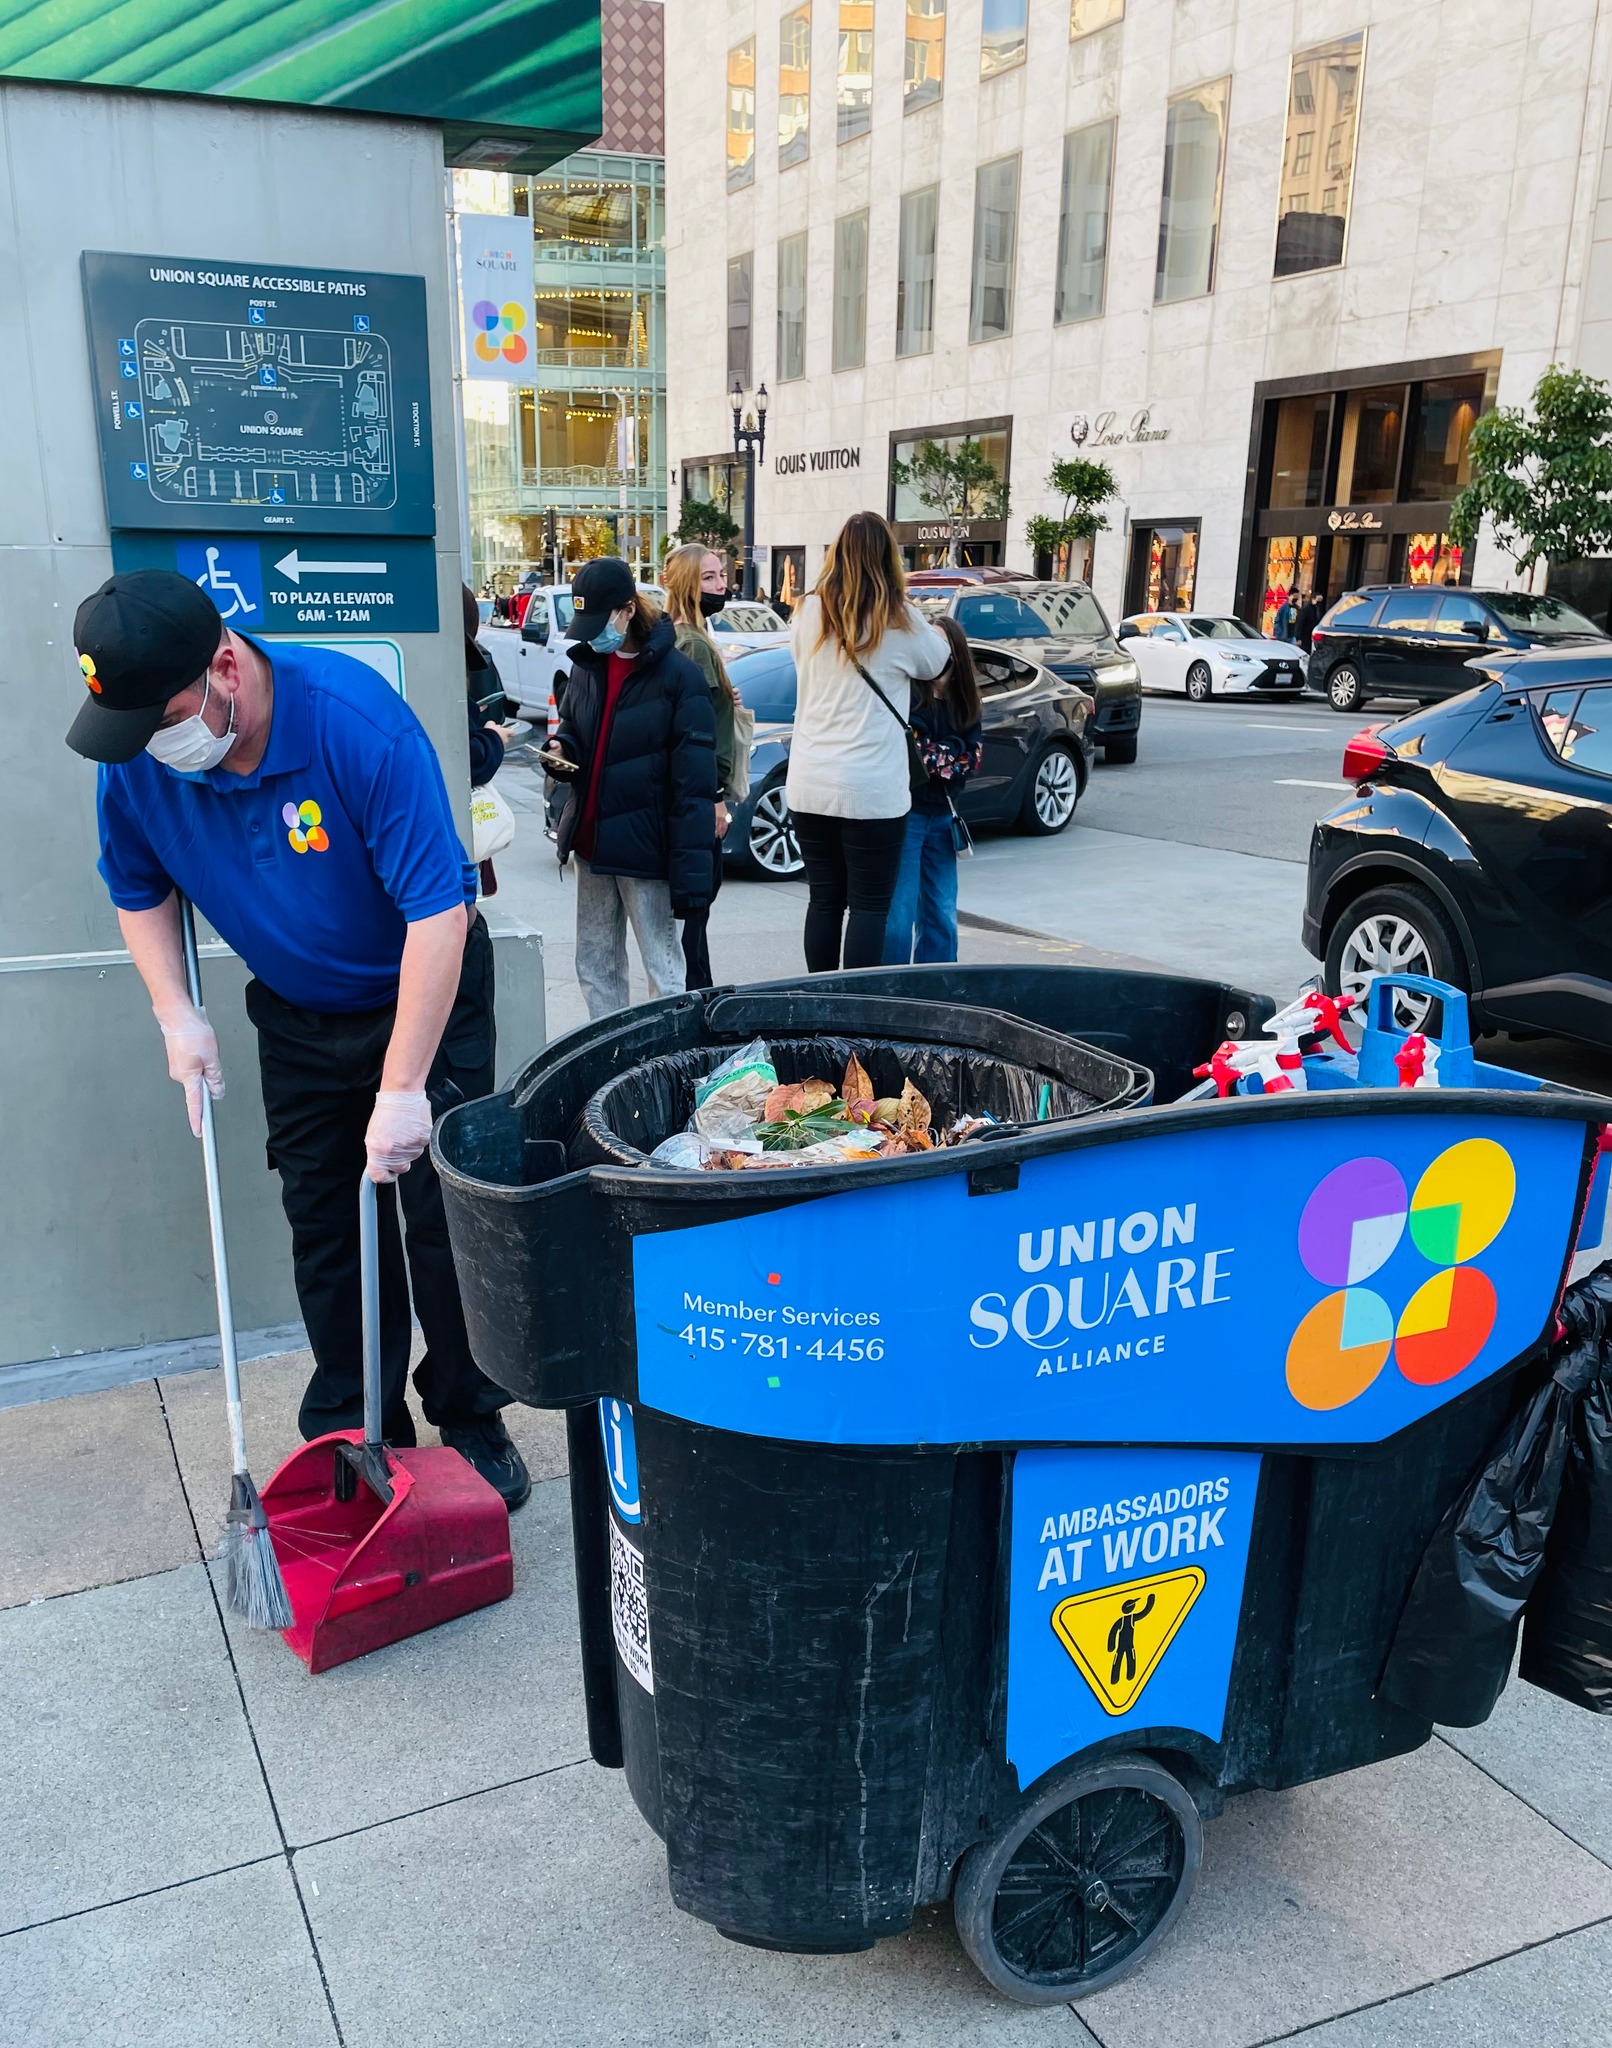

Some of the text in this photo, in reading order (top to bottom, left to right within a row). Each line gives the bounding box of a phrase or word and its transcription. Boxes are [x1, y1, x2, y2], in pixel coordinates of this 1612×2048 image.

[476, 259, 519, 272] SQUARE
[150, 268, 367, 297] UNION SQUARE ACCESSIBLE PATHS
[249, 299, 267, 307] POST
[112, 401, 121, 430] POWELL
[411, 402, 420, 437] STOCKTON
[1087, 403, 1173, 448] Loro Piana
[240, 425, 304, 436] UNION SQUARE
[775, 447, 861, 475] LOUIS VUITTON
[263, 516, 285, 524] GEARY
[918, 525, 970, 540] LOUIS VUION
[270, 592, 395, 605] TO PLAZA ELEVATOR
[297, 609, 326, 622] 6AM
[335, 609, 371, 622] 12AM
[1018, 1202, 1197, 1273] UNION
[683, 1292, 881, 1327] Member Services
[969, 1247, 1235, 1350] SQUARE
[1035, 1335, 1166, 1378] ALLIANCE
[1039, 1476, 1230, 1544] AMBASSADORS
[1037, 1506, 1228, 1592] AT WORK
[629, 1643, 650, 1674] WORK
